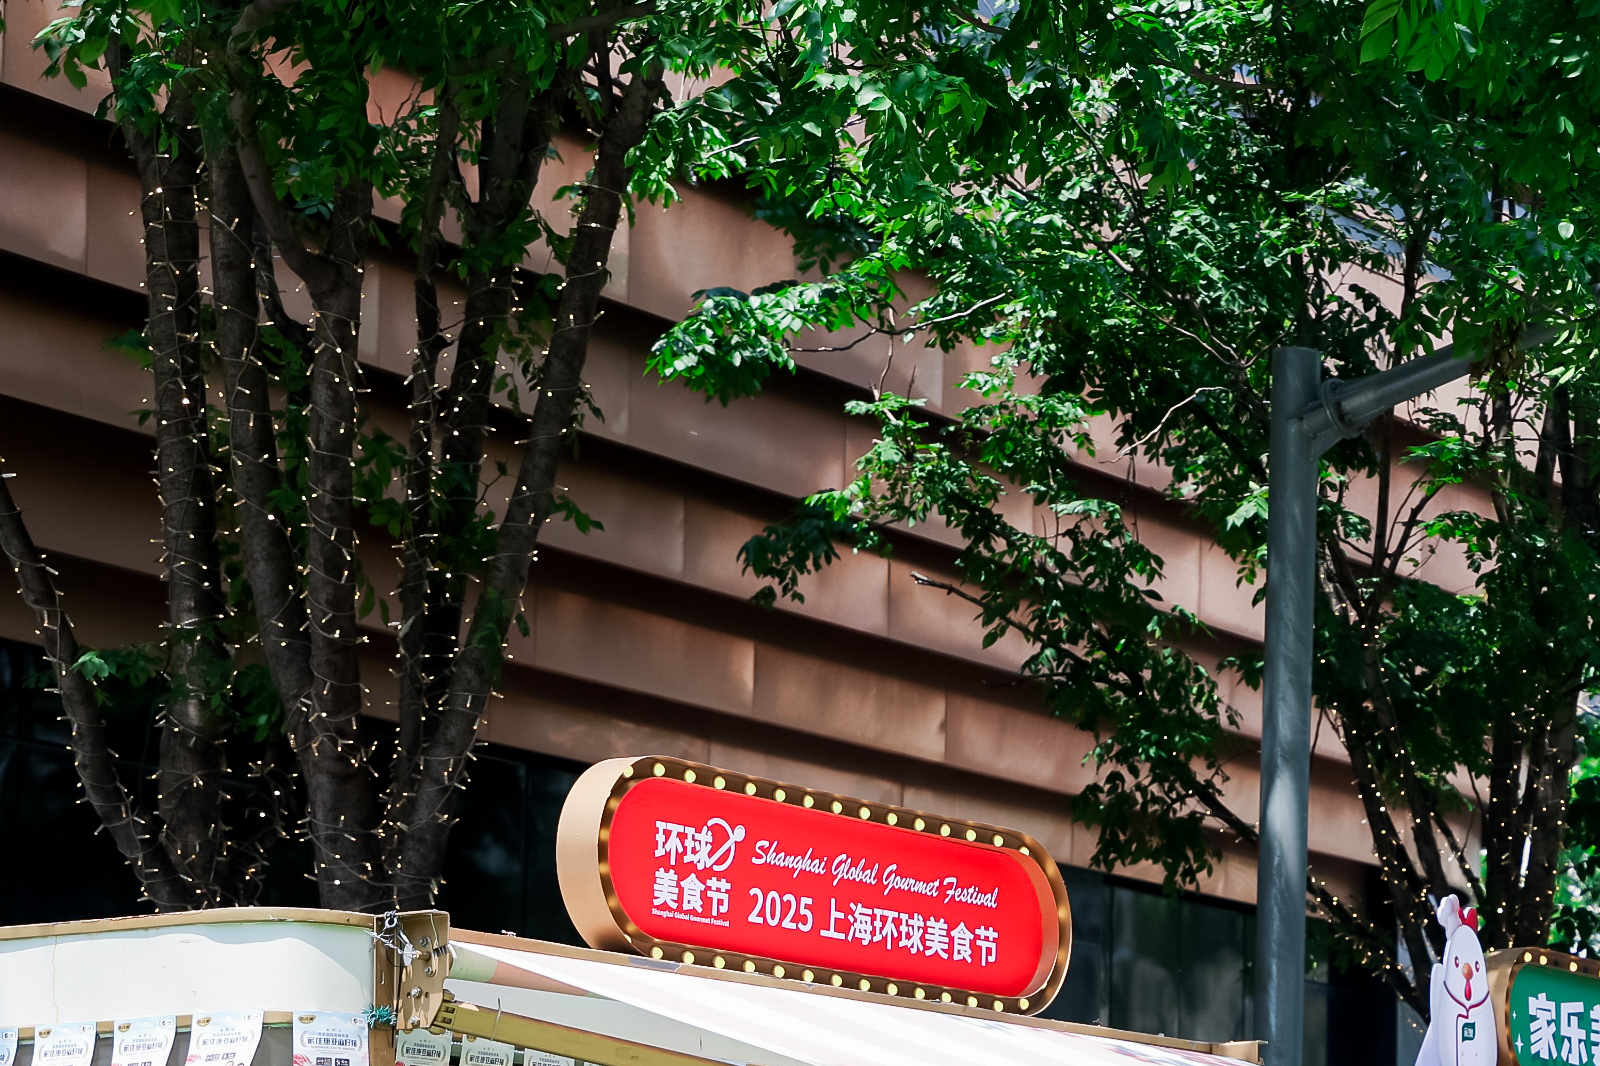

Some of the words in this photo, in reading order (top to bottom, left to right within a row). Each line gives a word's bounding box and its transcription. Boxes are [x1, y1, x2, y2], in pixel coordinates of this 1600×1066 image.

[655, 819, 713, 871] 环球
[751, 839, 827, 882] Shanghai
[831, 853, 878, 886] Global
[882, 867, 941, 900] Gourmet
[942, 876, 1000, 910] Festival
[653, 866, 732, 917] 美食节
[747, 886, 815, 934] 2025
[819, 896, 999, 968] 上海环球美食节
